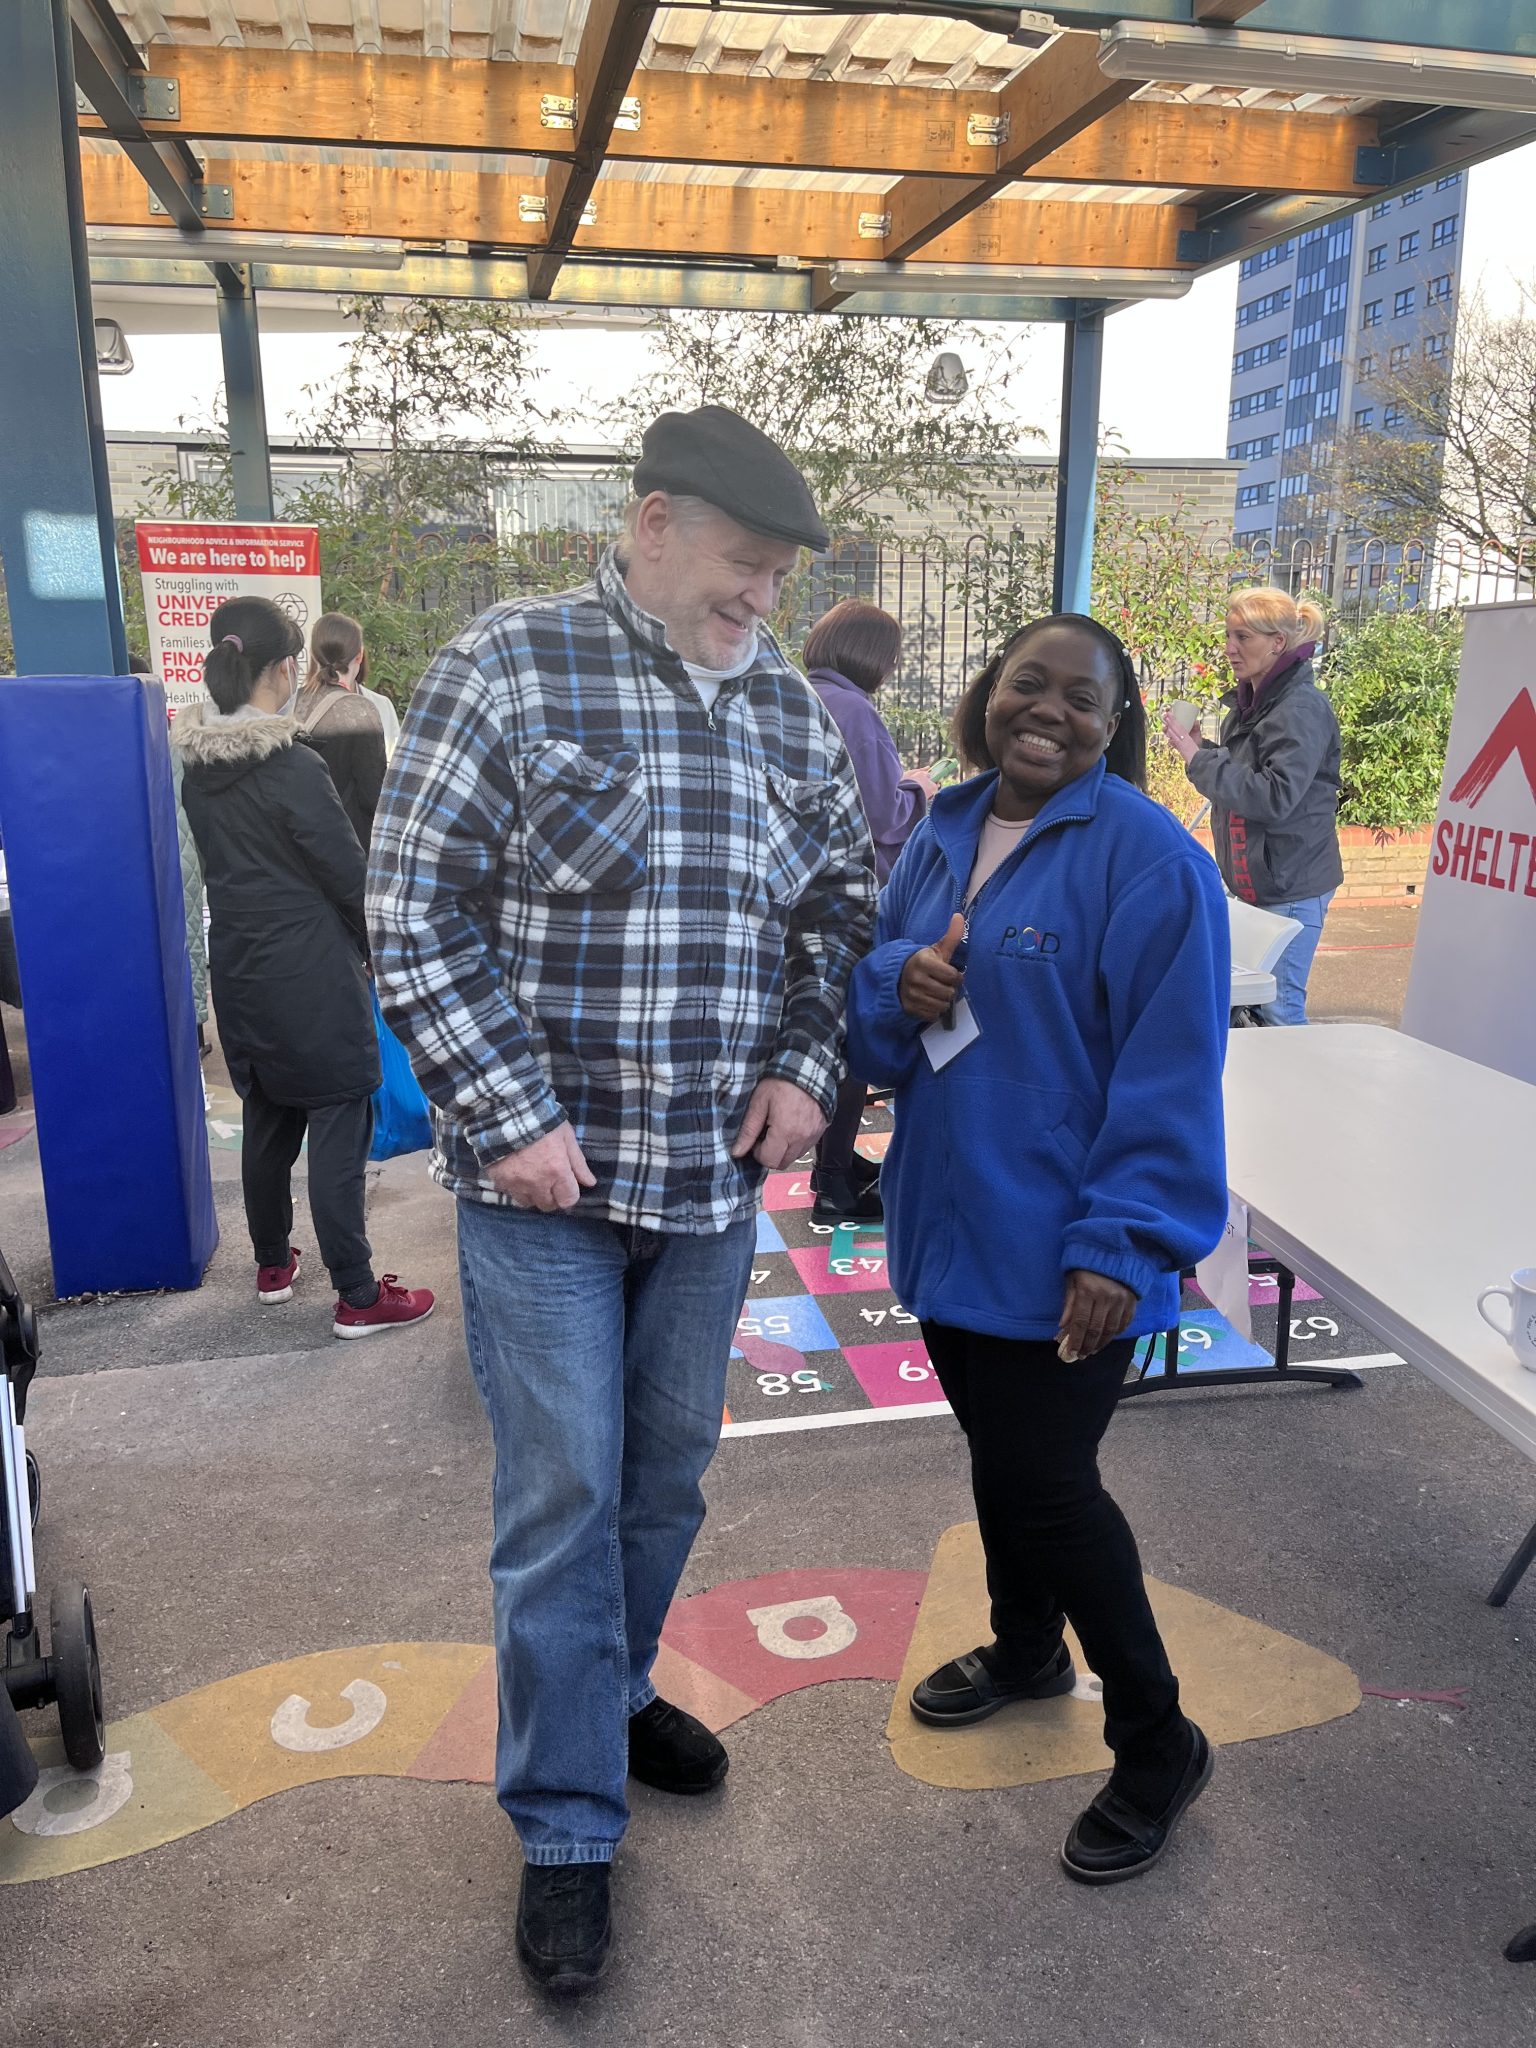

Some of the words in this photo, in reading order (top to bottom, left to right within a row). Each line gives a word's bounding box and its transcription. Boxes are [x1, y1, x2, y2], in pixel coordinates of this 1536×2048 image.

[148, 536, 204, 545] NEIGHBOURHOOD
[205, 537, 228, 546] ADVICE
[229, 538, 234, 546] &
[235, 538, 278, 547] INFORMATION
[280, 539, 304, 547] SERVICE
[149, 547, 177, 565] We
[180, 552, 206, 565] are
[210, 548, 246, 566] here
[249, 551, 266, 566] to
[269, 550, 306, 572] help
[155, 577, 212, 593] Struggling
[215, 579, 239, 591] with
[158, 612, 213, 626] CRED
[160, 636, 205, 648] Families
[165, 692, 200, 703] Health
[1001, 926, 1060, 954] POD
[831, 1257, 884, 1276] 43
[750, 1268, 771, 1285] 4
[859, 1304, 920, 1326] 54
[737, 1315, 791, 1337] 55
[756, 1369, 823, 1396] 58
